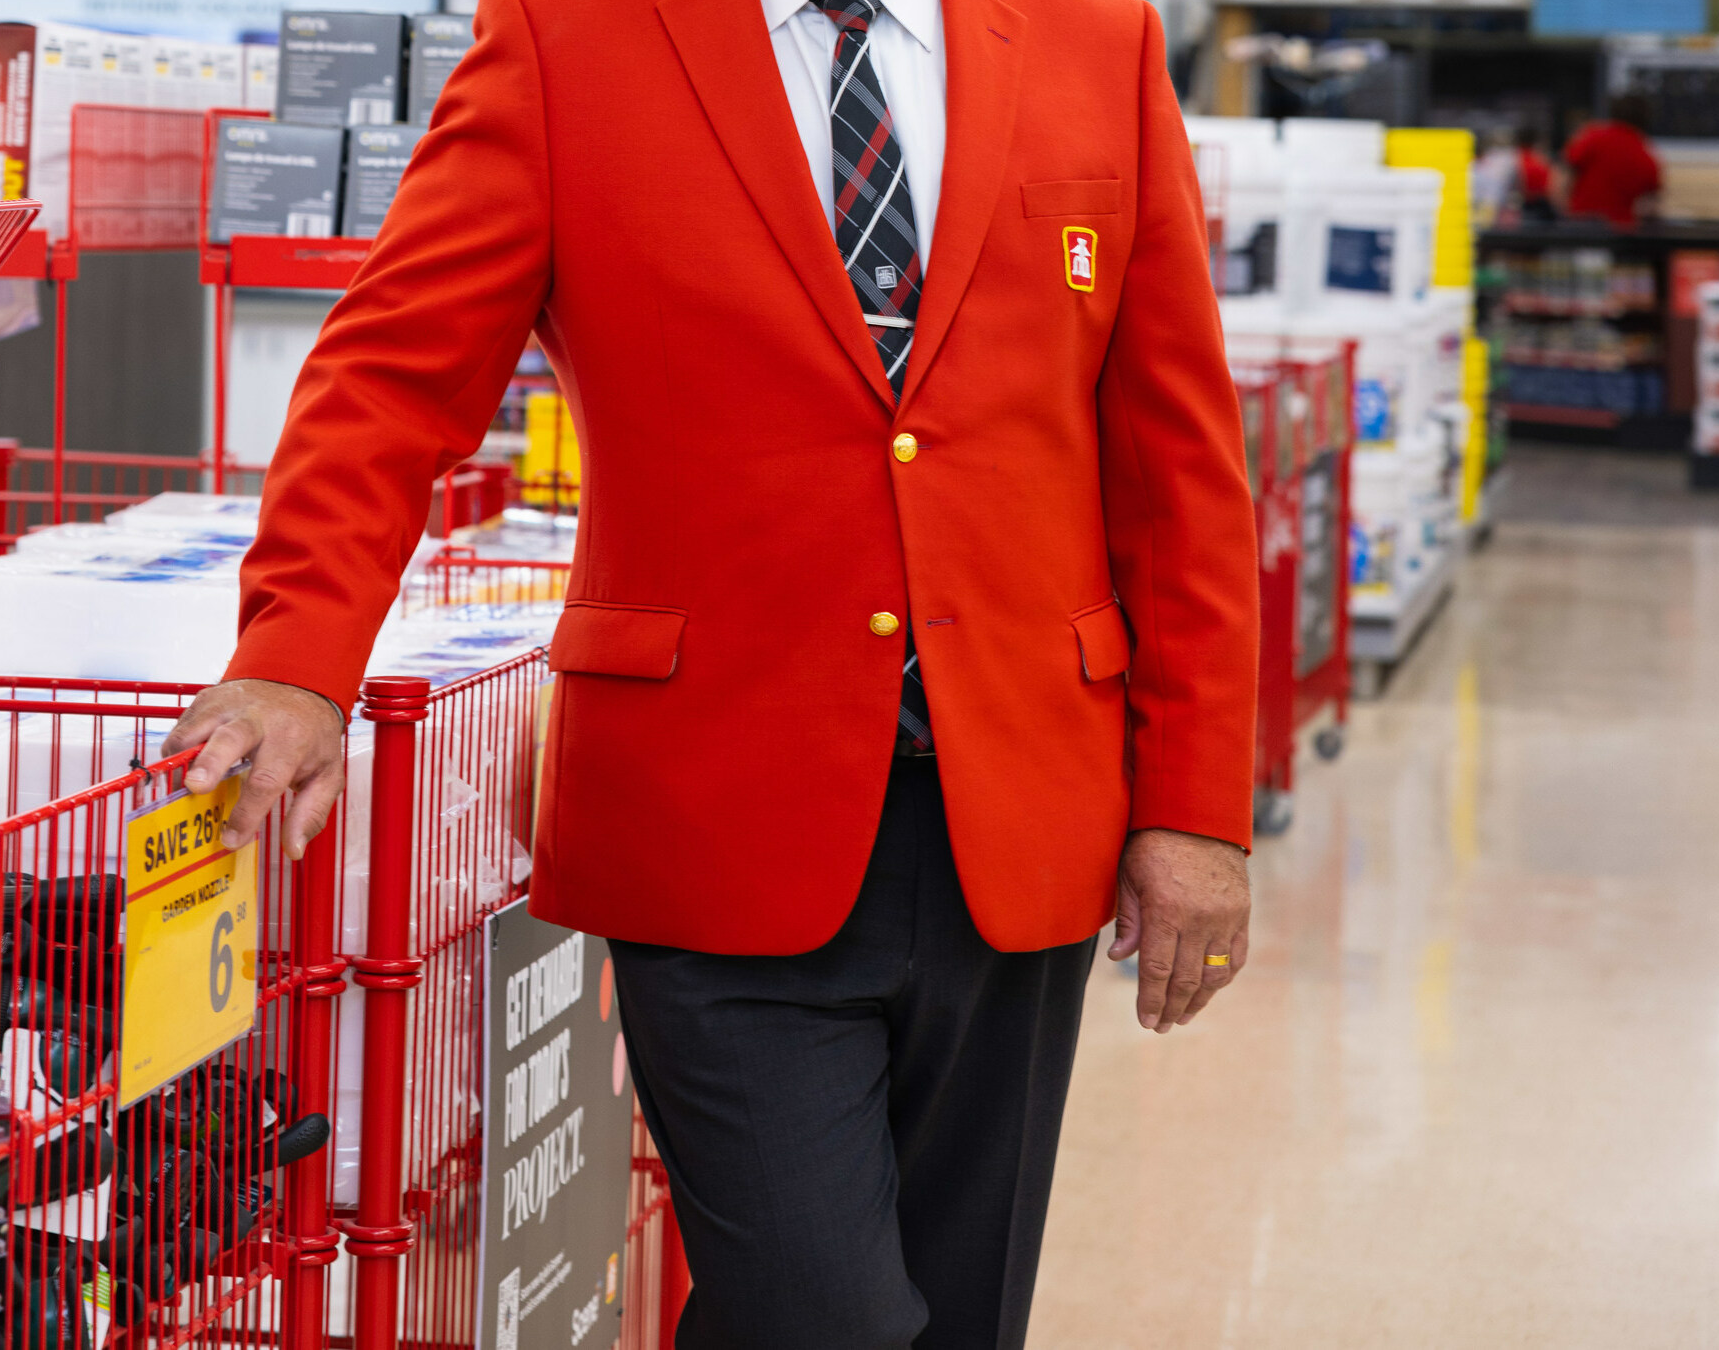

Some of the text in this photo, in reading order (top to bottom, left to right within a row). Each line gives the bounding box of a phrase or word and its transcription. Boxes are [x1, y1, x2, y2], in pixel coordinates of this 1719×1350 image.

[144, 819, 189, 873] SAVE
[162, 873, 230, 923] GARDEN NOZZLE
[209, 910, 235, 1014] 6
[506, 966, 529, 1051] GET
[504, 1062, 528, 1148] FOR
[501, 1106, 585, 1241] PROJECT.
